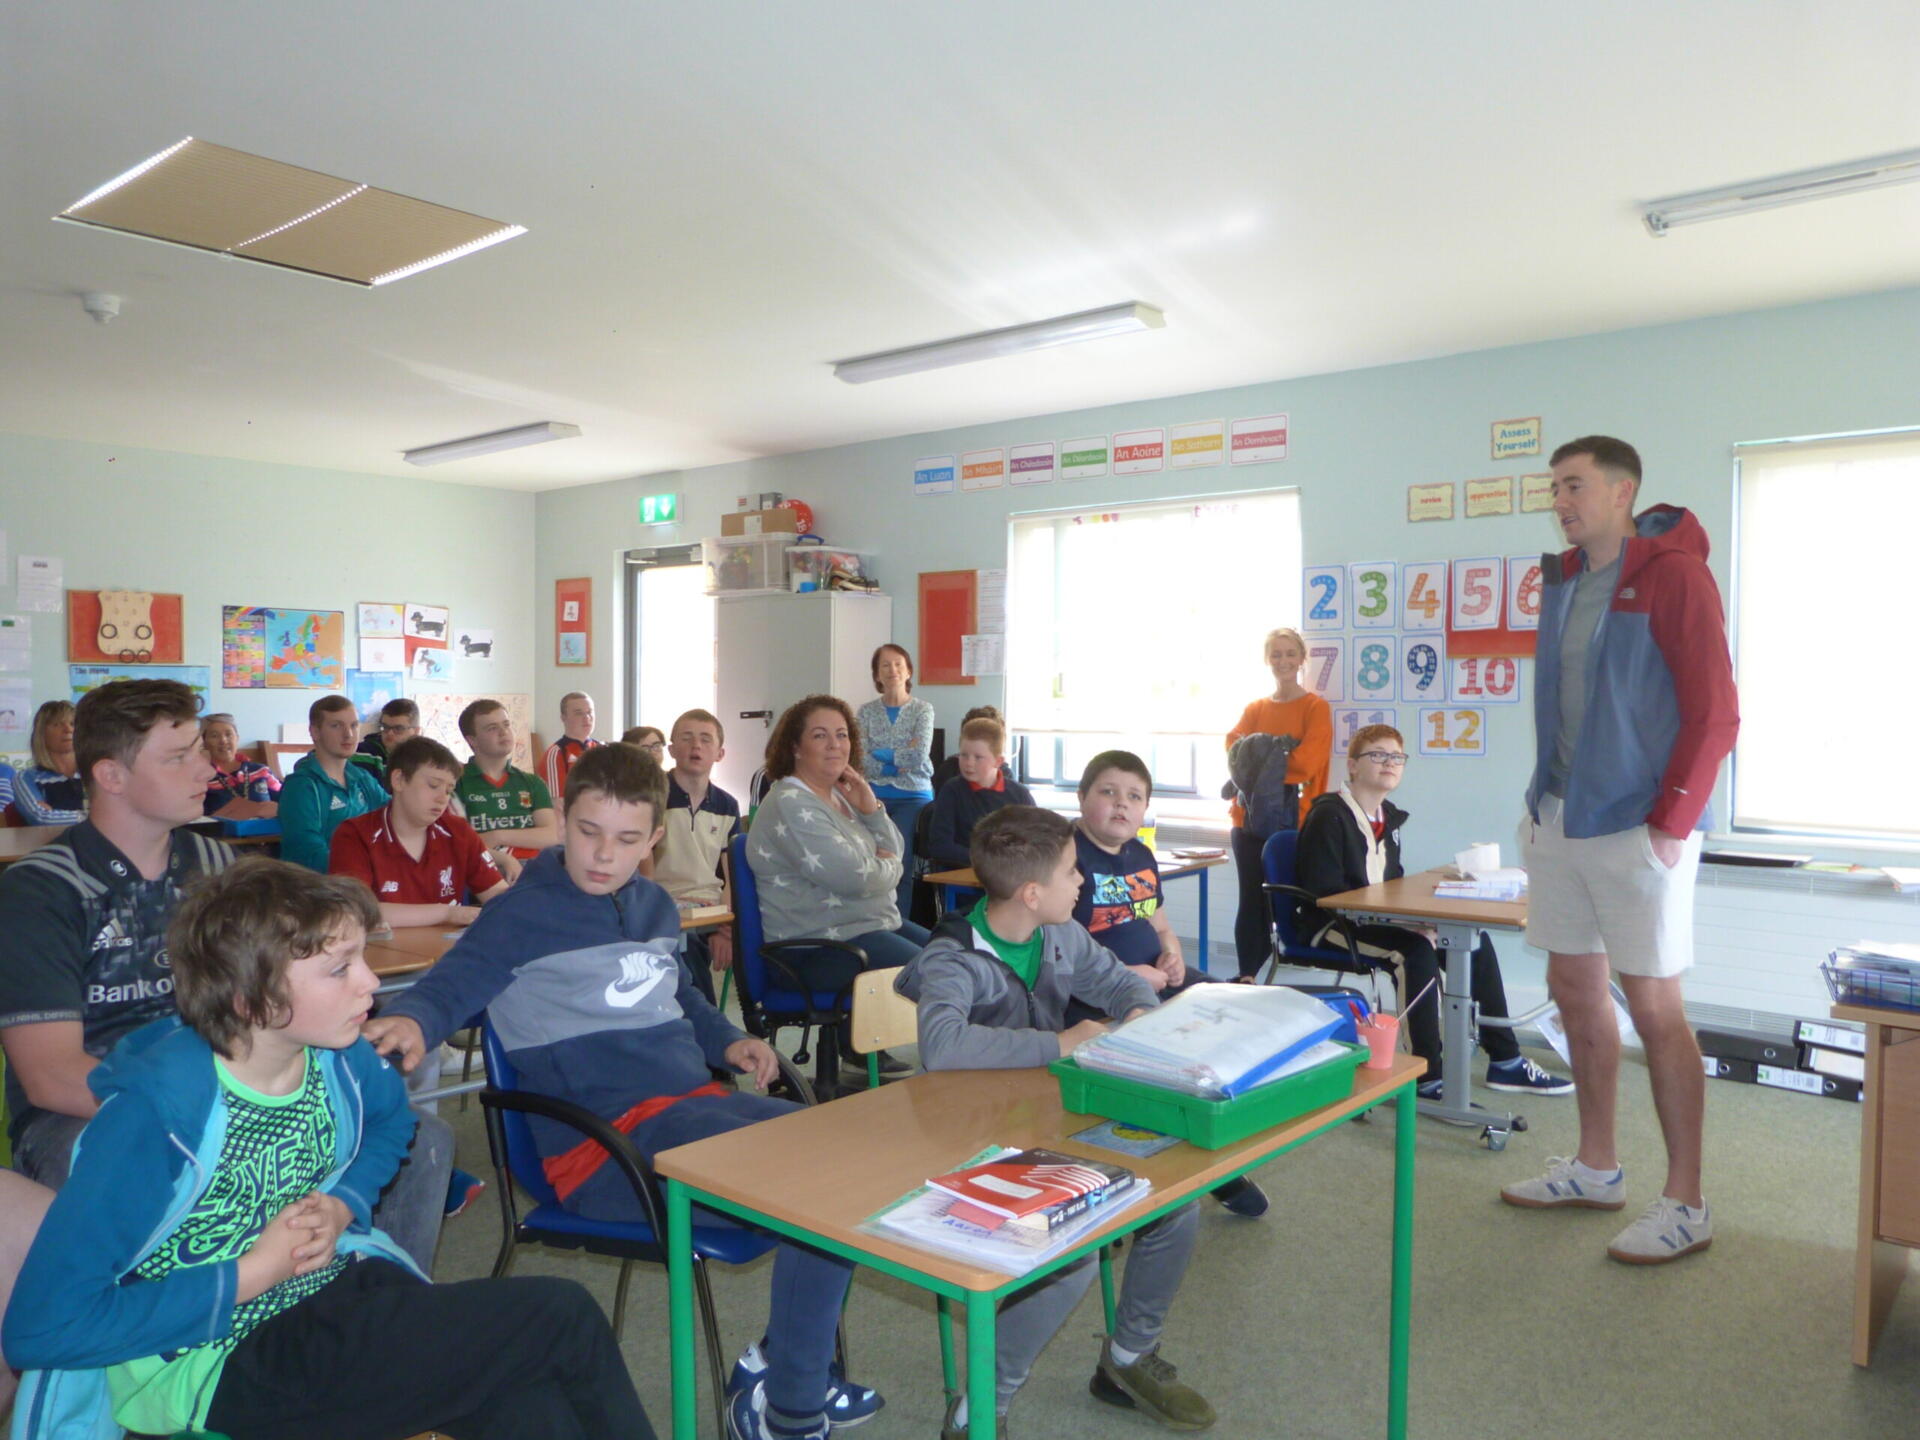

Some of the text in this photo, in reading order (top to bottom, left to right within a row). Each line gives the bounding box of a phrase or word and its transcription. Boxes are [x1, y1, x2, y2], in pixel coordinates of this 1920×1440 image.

[1116, 446, 1161, 459] An Aoine
[1496, 438, 1536, 452] Yourself
[1500, 428, 1531, 439] Assess
[915, 469, 952, 481] An Luan
[1309, 574, 1337, 619] 2
[1358, 571, 1387, 617] 3
[1407, 573, 1440, 618] 4
[1460, 568, 1492, 616] 5
[1516, 566, 1542, 615] 6
[1309, 647, 1338, 691] 7
[1358, 644, 1390, 690] 8
[1407, 644, 1437, 690] 9
[1459, 657, 1515, 695] 10
[1427, 710, 1480, 749] 12
[470, 812, 534, 832] Elverys
[498, 798, 508, 810] 8
[88, 979, 154, 1004] Bank
[188, 1133, 304, 1217] LIVE
